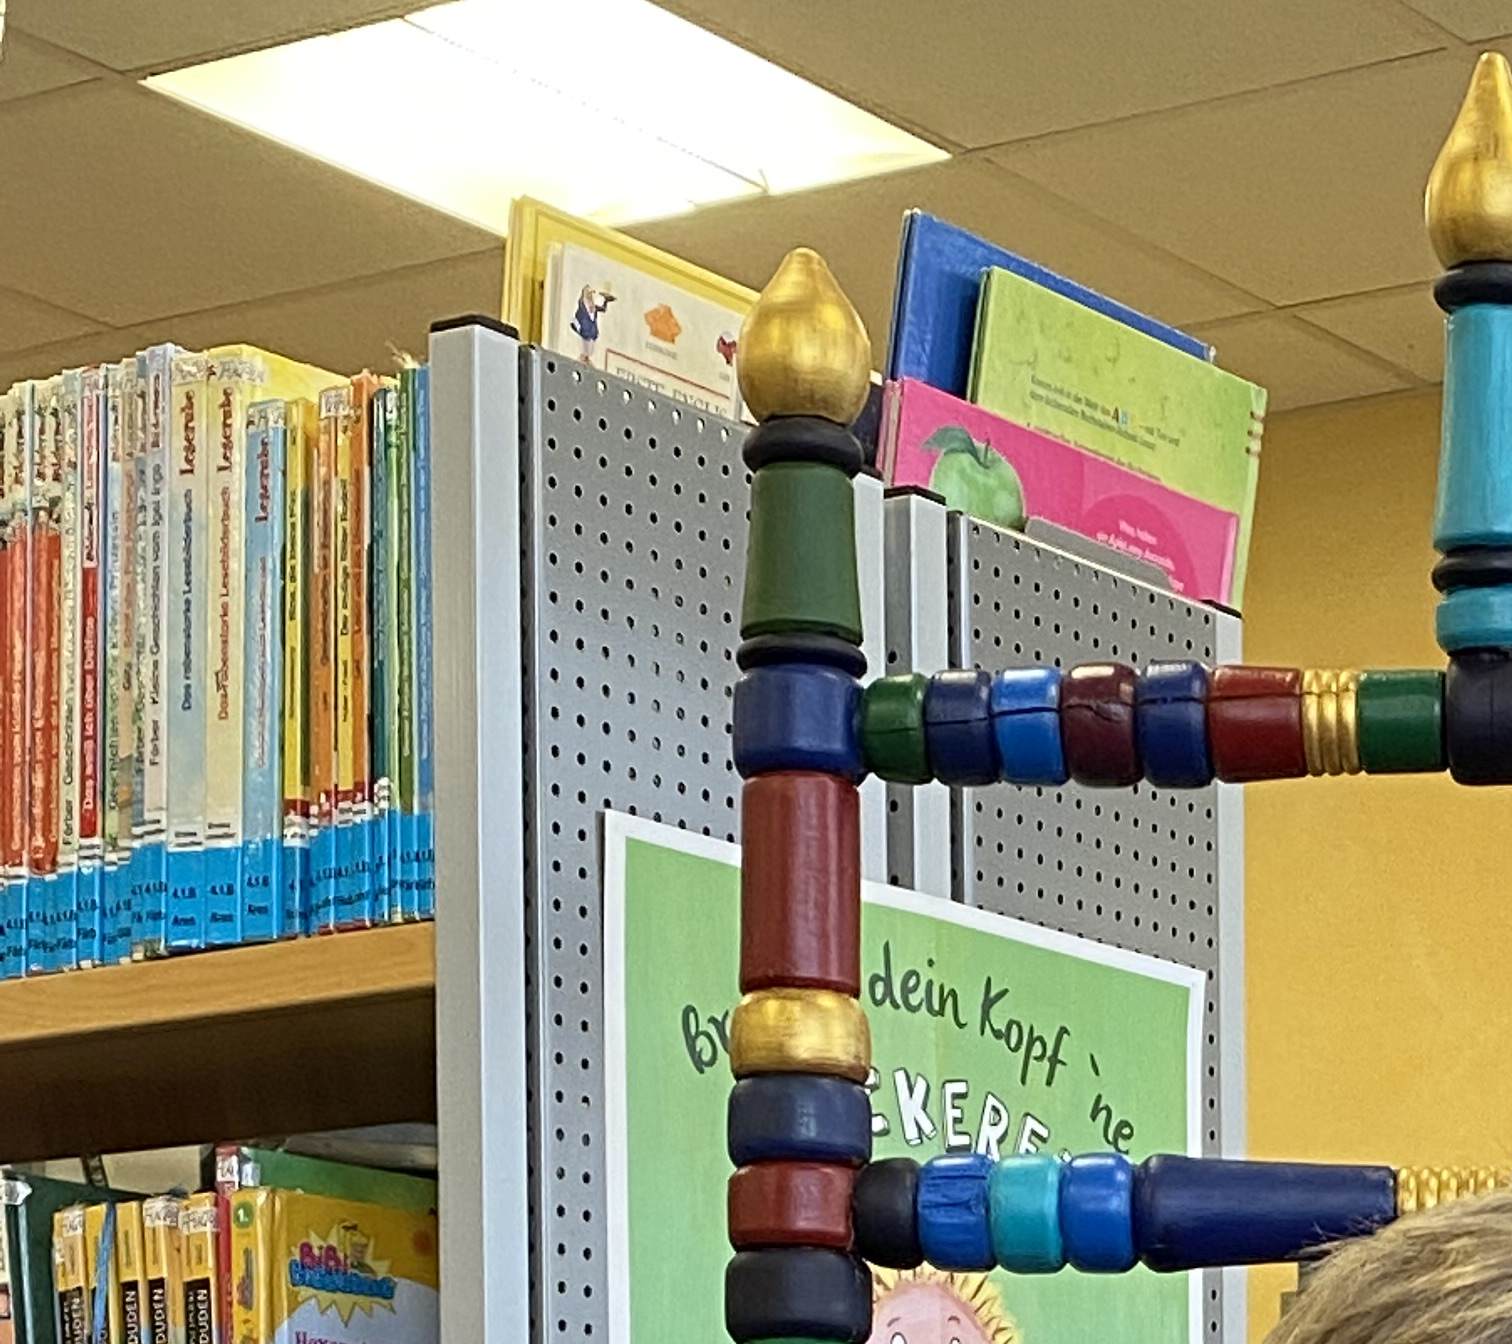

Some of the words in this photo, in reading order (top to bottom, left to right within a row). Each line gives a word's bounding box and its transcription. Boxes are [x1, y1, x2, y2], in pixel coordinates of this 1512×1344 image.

[680, 1002, 732, 1074] Br
[868, 940, 968, 1028] dein
[980, 976, 1071, 1086] Kopf
[153, 1288, 166, 1344] DUDEN
[197, 1288, 208, 1344] DUDEN
